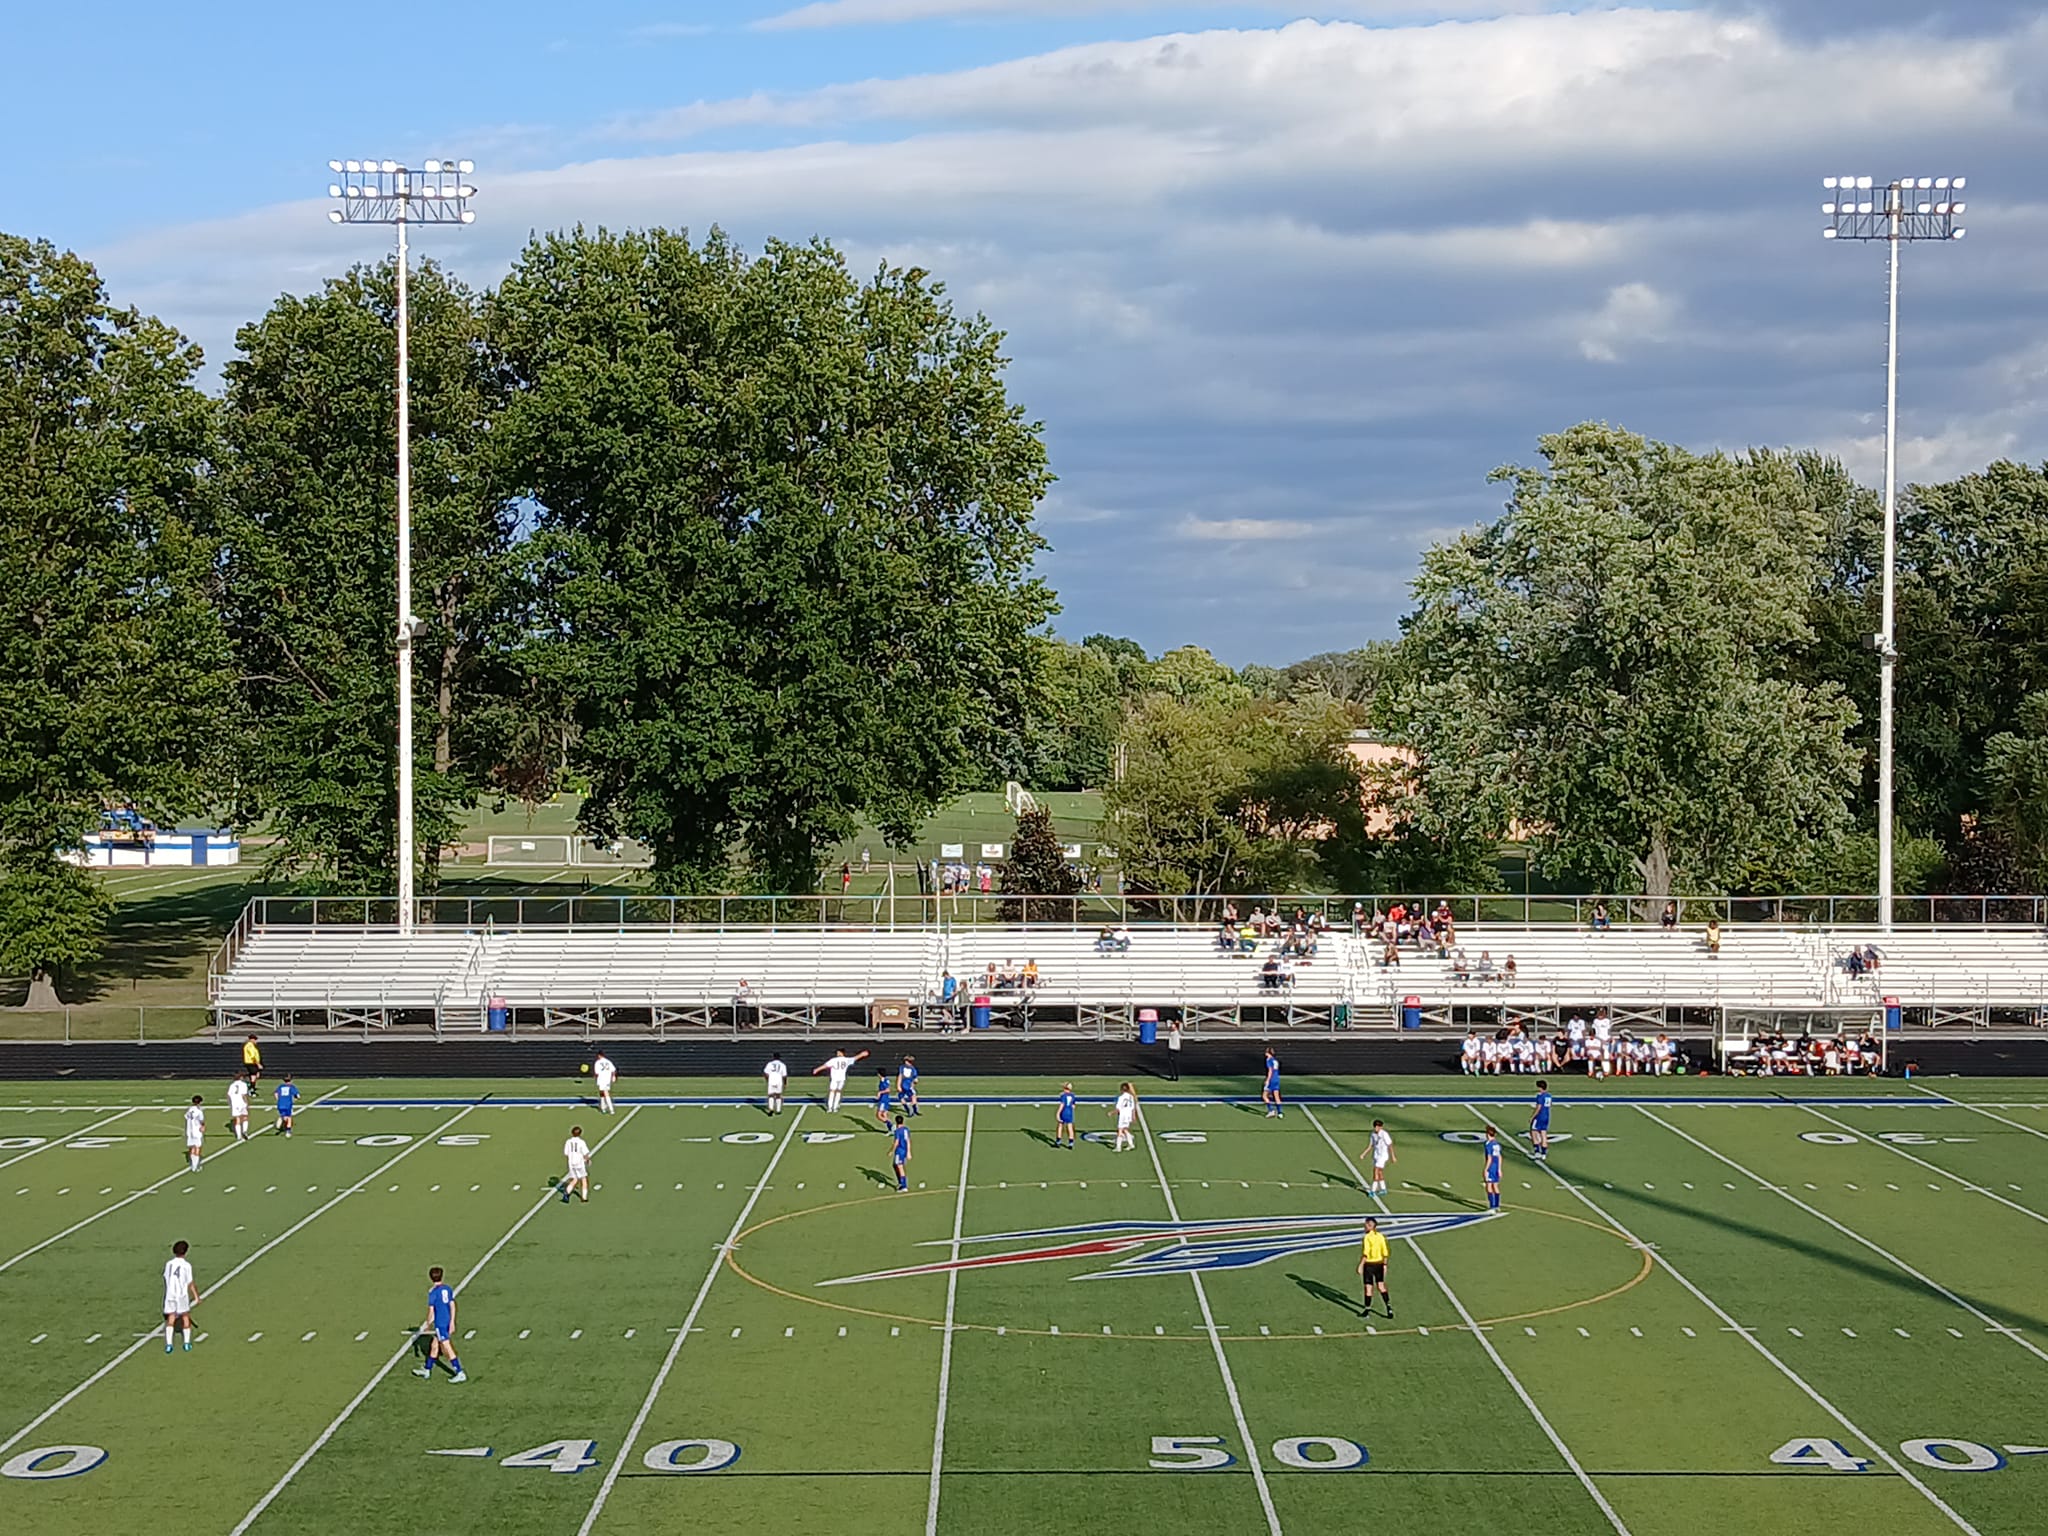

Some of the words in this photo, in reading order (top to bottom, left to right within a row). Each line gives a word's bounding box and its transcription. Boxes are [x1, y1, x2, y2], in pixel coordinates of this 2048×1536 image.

[771, 1063, 780, 1072] 31
[571, 1142, 578, 1153] 11
[169, 1264, 181, 1279] 14
[441, 1289, 449, 1304] 8
[0, 1444, 110, 1480] 0
